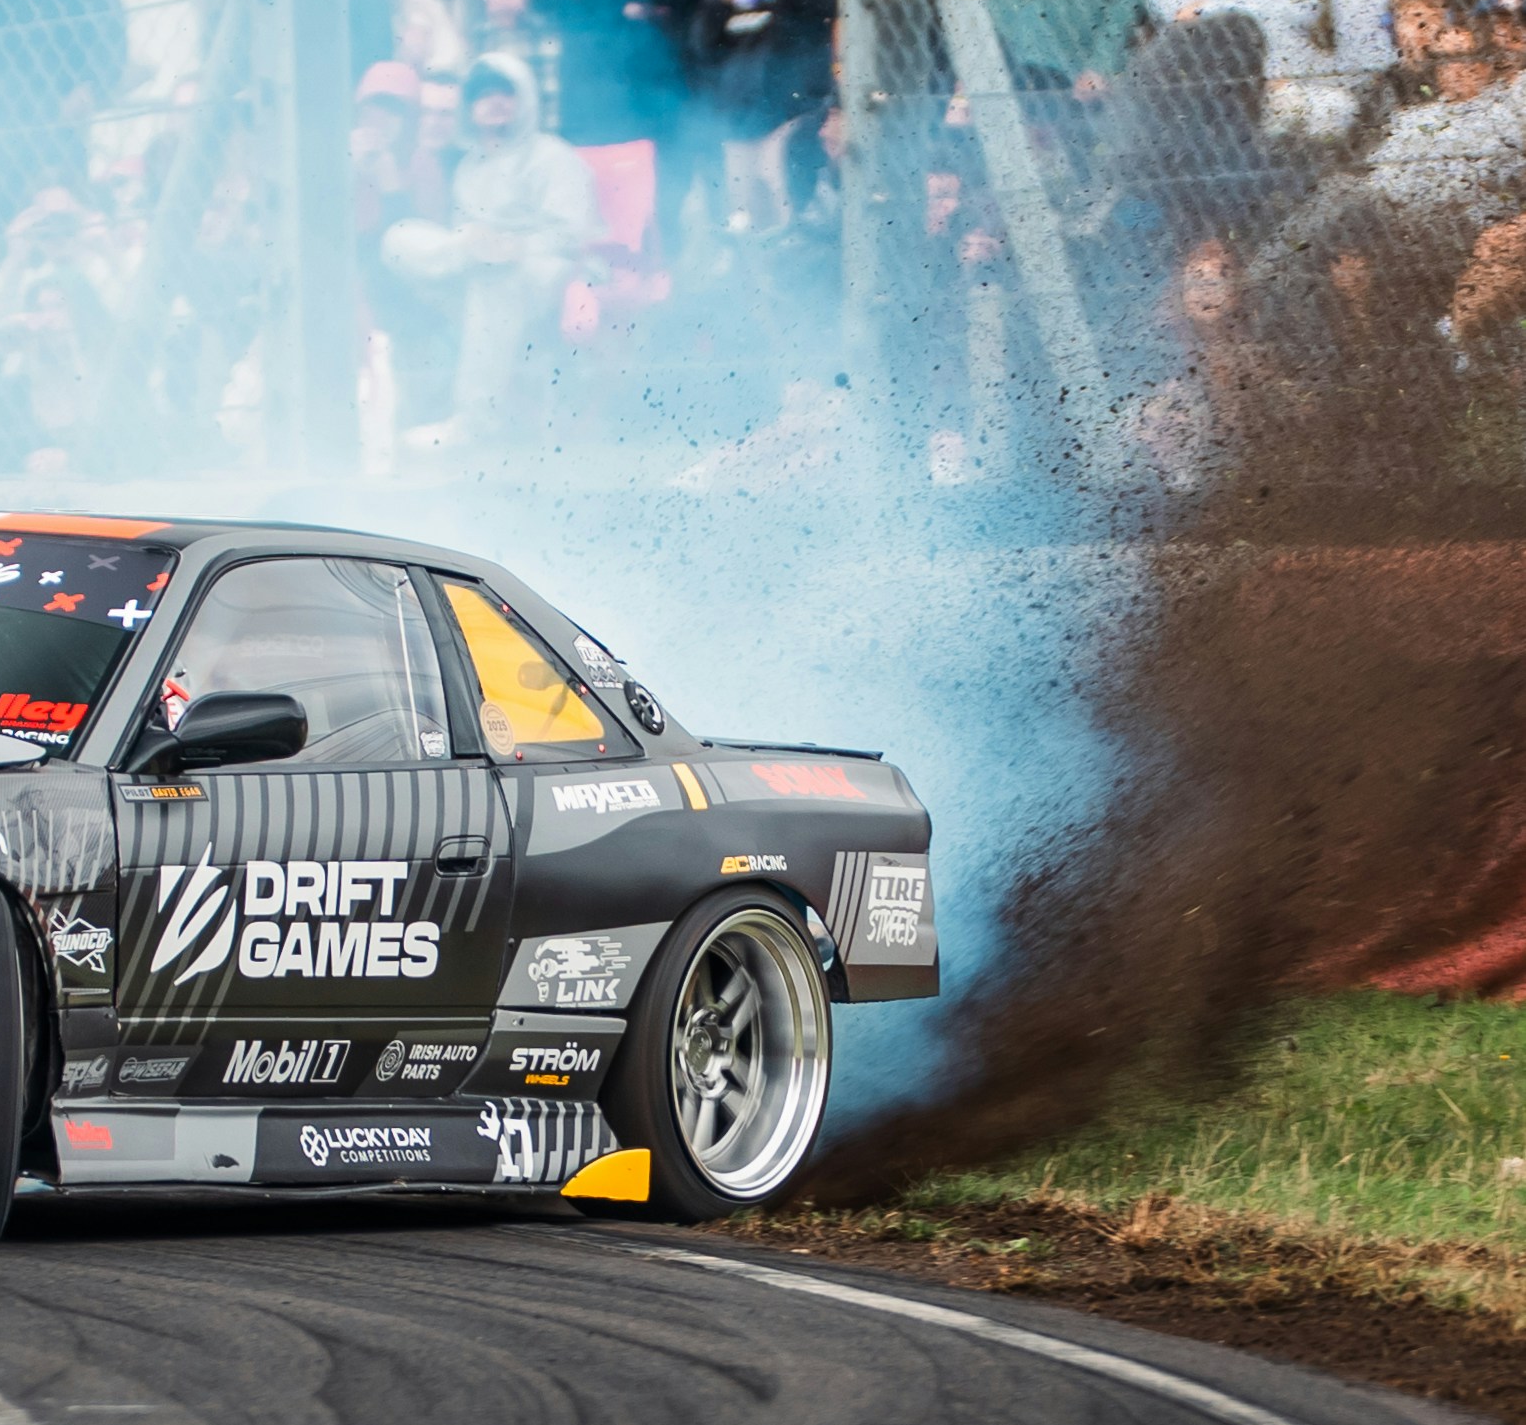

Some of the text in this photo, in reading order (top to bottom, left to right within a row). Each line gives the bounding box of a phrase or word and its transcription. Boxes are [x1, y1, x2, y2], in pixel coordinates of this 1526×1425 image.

[487, 720, 508, 732] 2025
[123, 788, 151, 797] PILOT
[747, 854, 788, 872] RACING
[243, 860, 409, 916] DRIFT
[870, 874, 925, 904] TIRE
[866, 908, 920, 947] STREETS
[52, 932, 108, 952] SUNOCO
[238, 921, 441, 978] GAMES
[556, 978, 621, 1003] LINK
[222, 1040, 319, 1083] Mobil
[408, 1043, 478, 1062] IRISH AUTO
[509, 1041, 601, 1073] STRÖM
[401, 1064, 443, 1080] PARTS
[525, 1074, 571, 1087] WHEELS
[340, 1149, 432, 1164] COMPETITIONS
